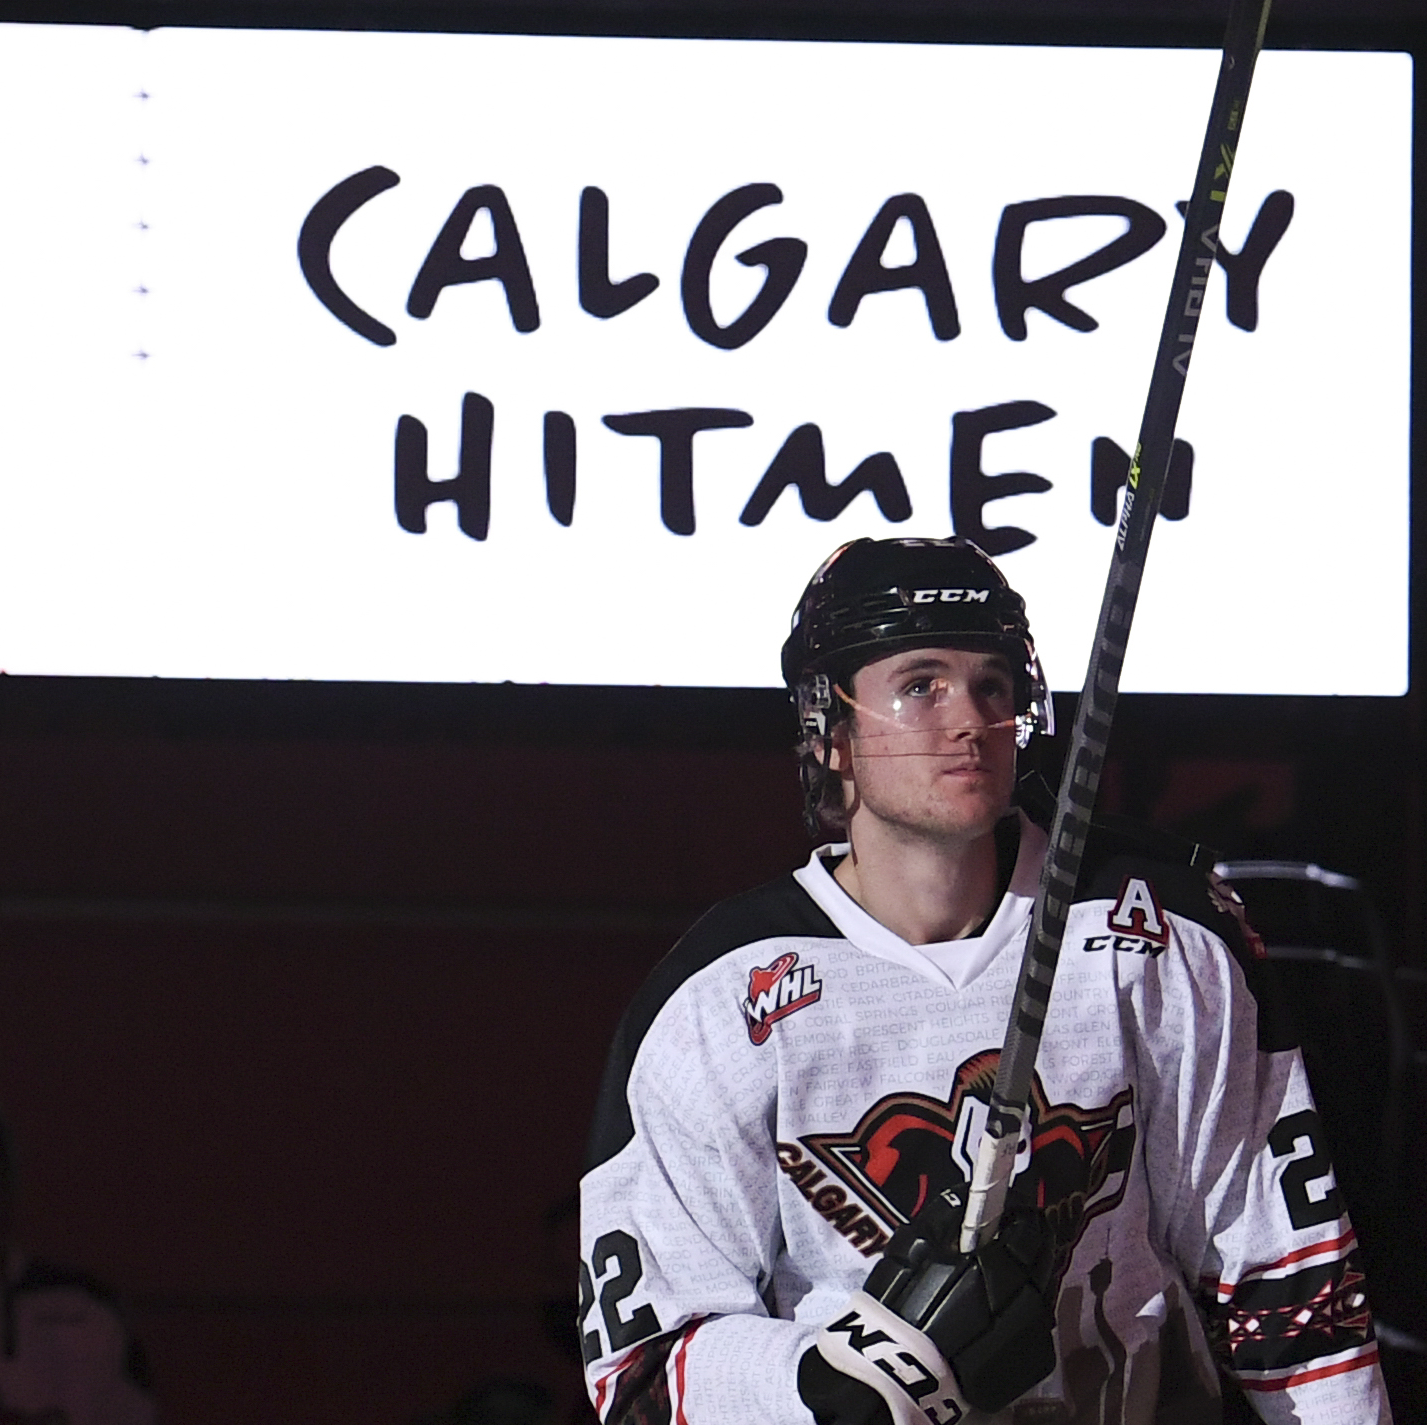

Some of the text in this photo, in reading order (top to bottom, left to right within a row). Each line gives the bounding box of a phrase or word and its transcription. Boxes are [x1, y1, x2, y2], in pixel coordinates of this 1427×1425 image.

[296, 164, 1294, 350] CALGARY
[394, 392, 1194, 558] HITMEN
[912, 587, 991, 605] CCM
[1111, 876, 1164, 937] A
[1082, 934, 1168, 959] CCM
[745, 963, 824, 1023] WHL
[776, 1141, 890, 1259] CALGARY
